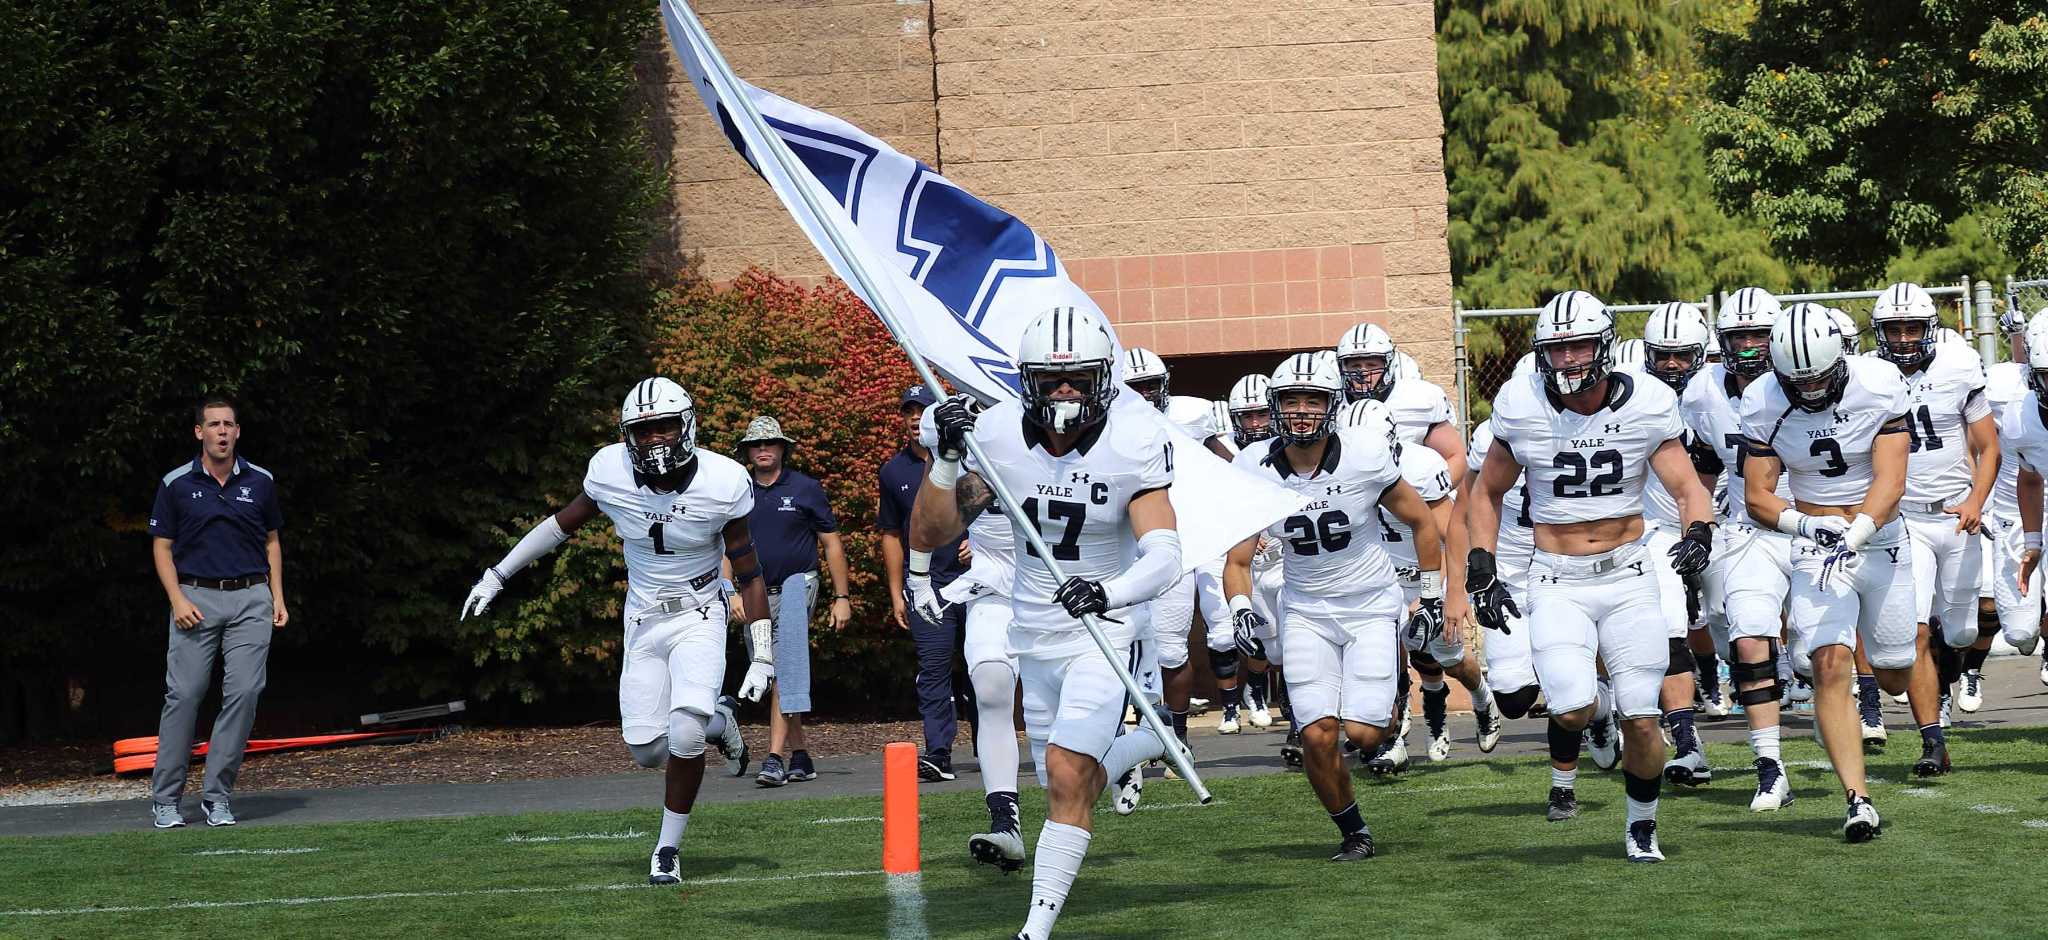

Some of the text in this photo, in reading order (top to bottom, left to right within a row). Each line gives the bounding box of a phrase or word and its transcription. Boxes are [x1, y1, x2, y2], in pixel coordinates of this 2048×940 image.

[1807, 427, 1837, 438] YALE
[1570, 438, 1605, 448] YALE
[1809, 438, 1848, 477] 3
[1553, 449, 1624, 497] 22
[1036, 484, 1073, 497] YALE
[1091, 482, 1109, 505] C
[643, 511, 673, 523] YALE
[1021, 496, 1087, 561] 17
[1284, 510, 1351, 556] 26
[648, 521, 675, 555] 1
[1884, 546, 1900, 563] Y
[1627, 561, 1644, 577] Y
[696, 606, 710, 620] Y
